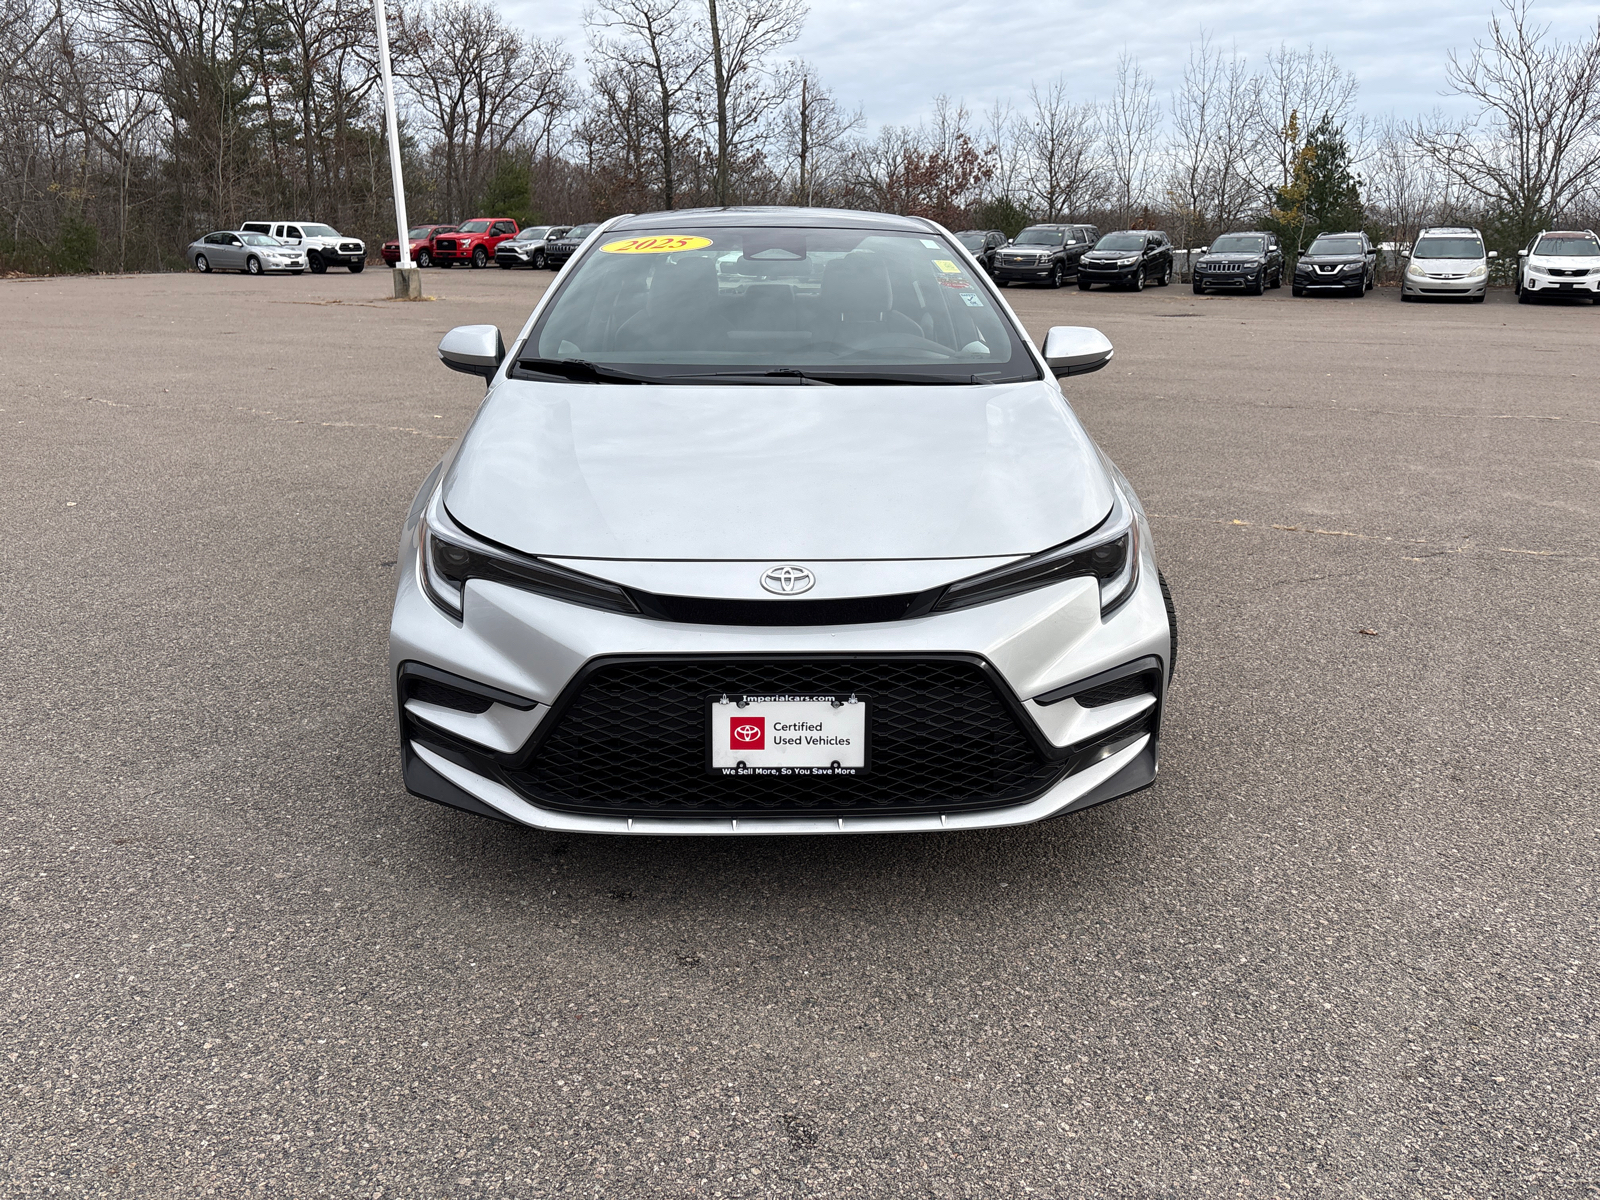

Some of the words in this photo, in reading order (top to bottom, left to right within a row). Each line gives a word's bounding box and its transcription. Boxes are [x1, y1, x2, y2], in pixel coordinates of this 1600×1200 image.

[614, 238, 694, 251] 2025
[742, 695, 836, 703] Imperialcars.com
[773, 721, 823, 732] Certified
[773, 735, 802, 745] Used
[805, 735, 851, 746] Vehicles
[756, 768, 779, 776] More,
